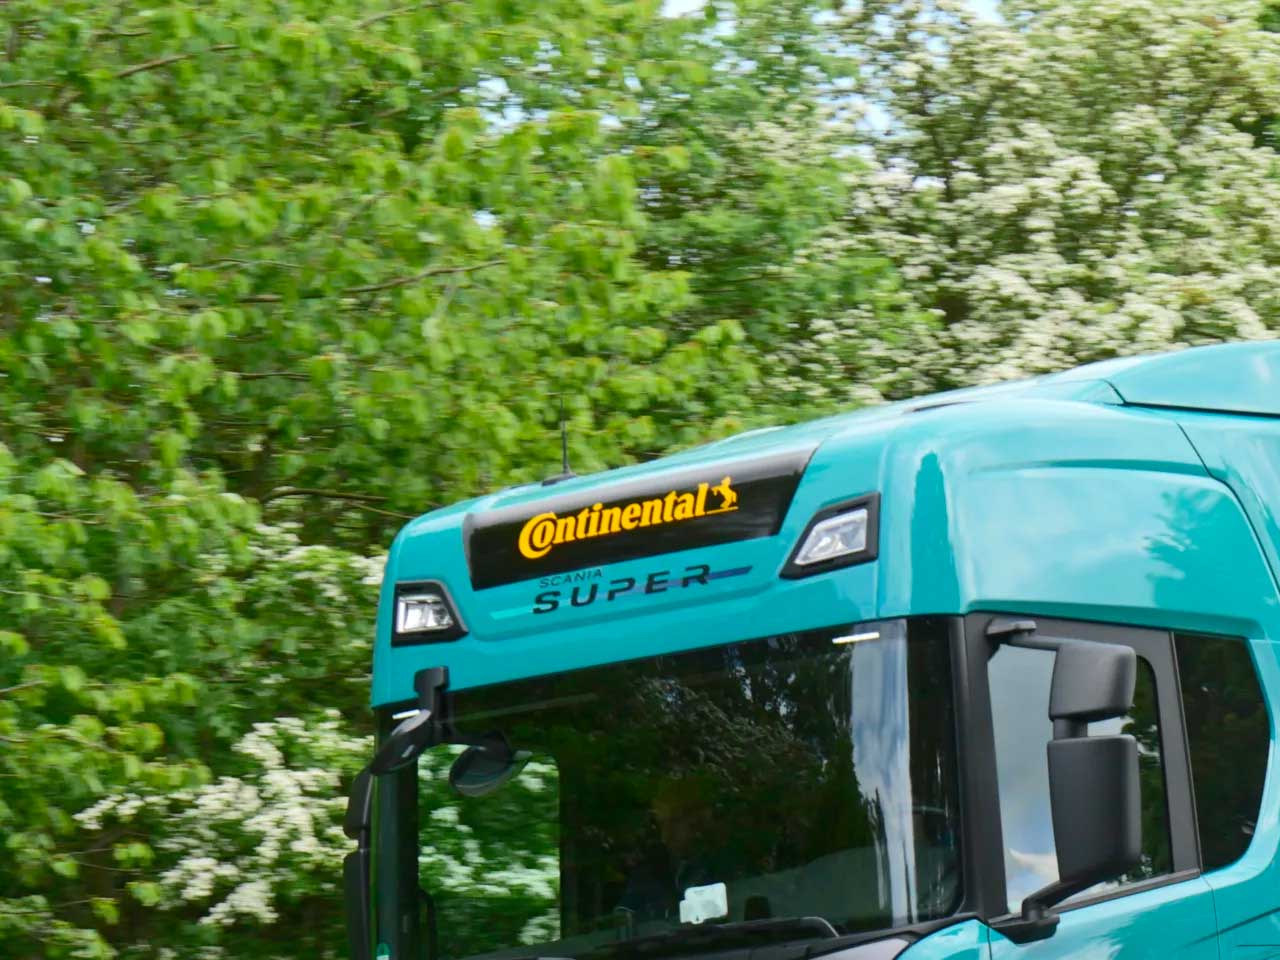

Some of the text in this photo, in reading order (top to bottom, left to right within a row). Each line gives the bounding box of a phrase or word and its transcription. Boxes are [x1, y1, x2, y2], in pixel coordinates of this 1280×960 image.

[518, 482, 708, 560] Continental
[532, 564, 711, 614] SUPER
[539, 568, 603, 588] SCANIA
